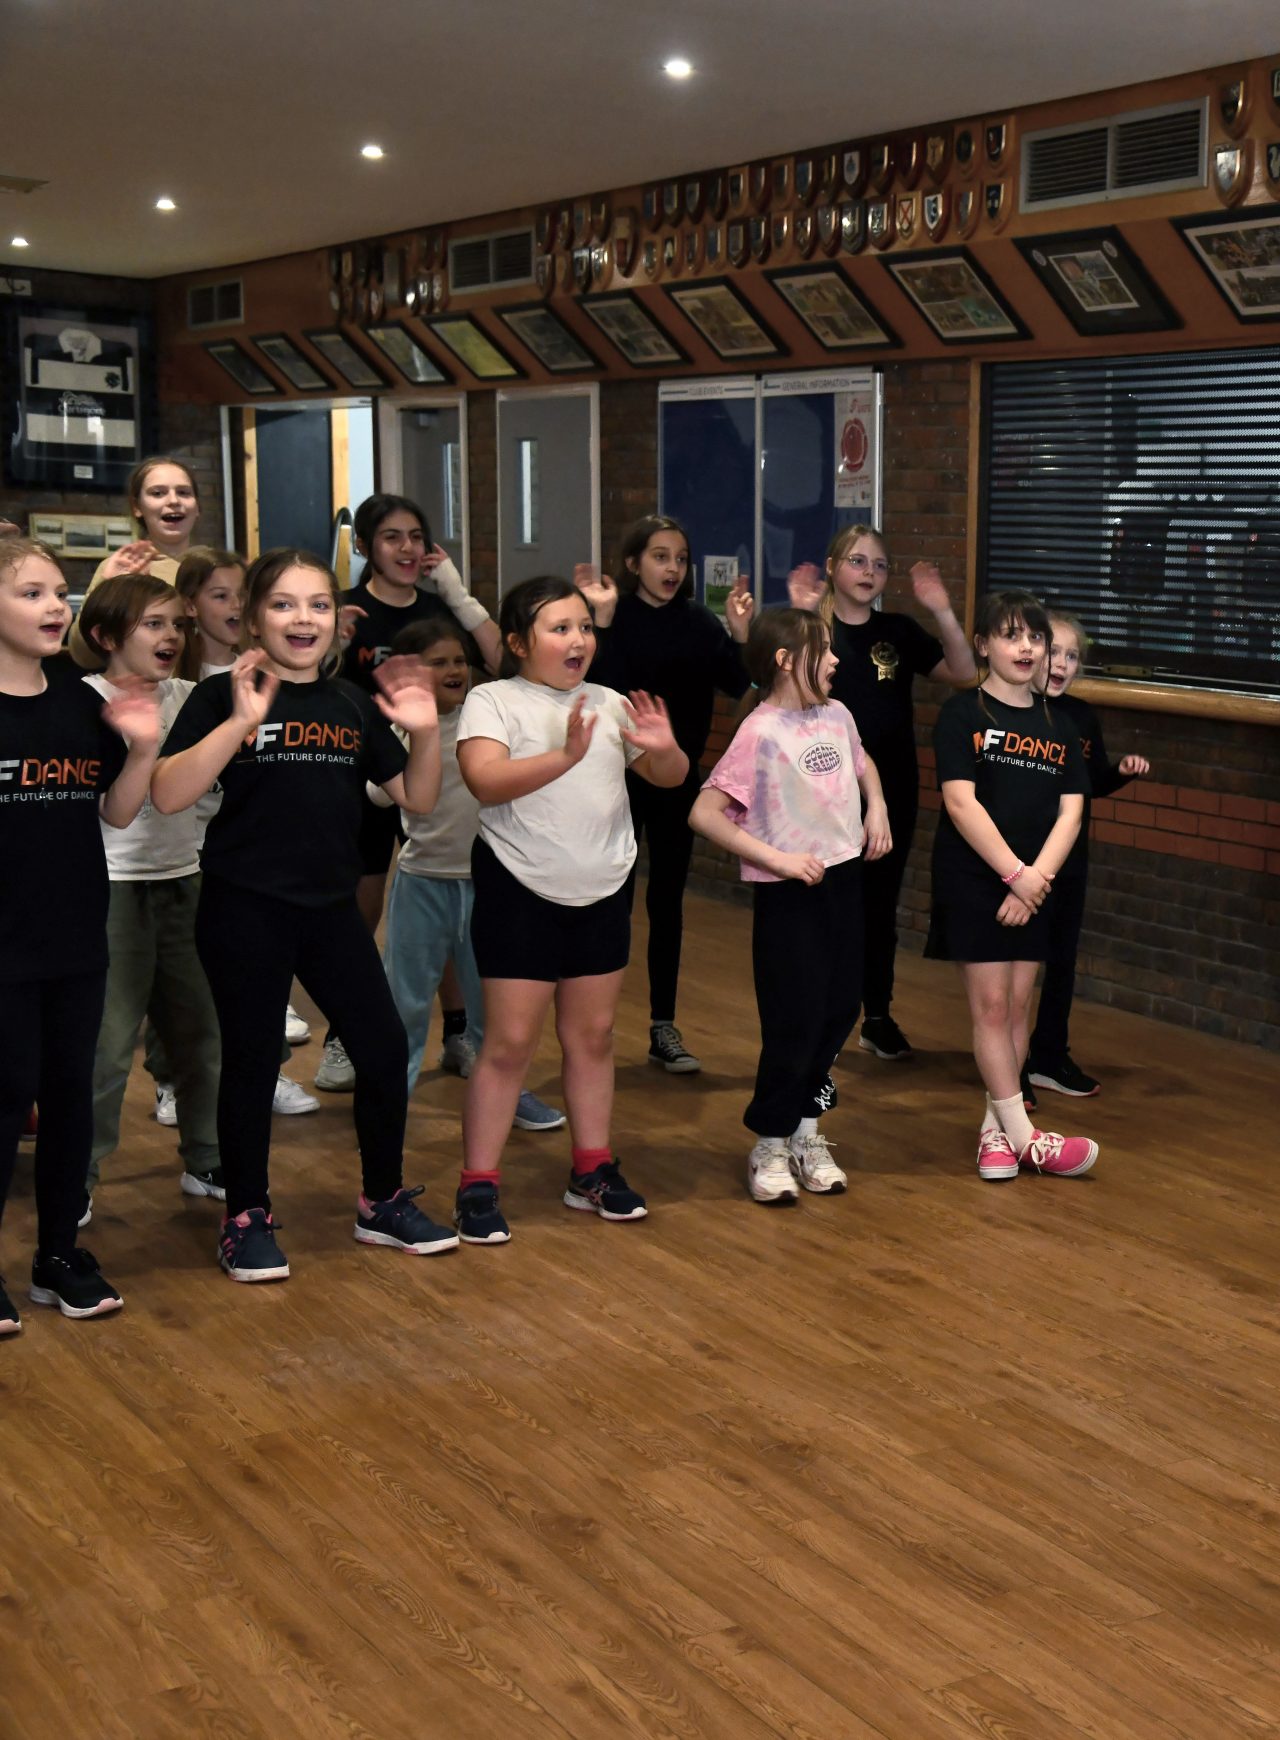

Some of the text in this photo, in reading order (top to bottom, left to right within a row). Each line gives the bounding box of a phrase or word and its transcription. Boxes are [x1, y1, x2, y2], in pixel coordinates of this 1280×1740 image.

[256, 753, 355, 765] THE FUTURE OF DANCE
[996, 756, 1025, 767] FUTURE
[1037, 763, 1057, 775] DANCE
[13, 791, 54, 802] FUTUE
[56, 791, 69, 800] OF
[71, 791, 95, 800] DANCE
